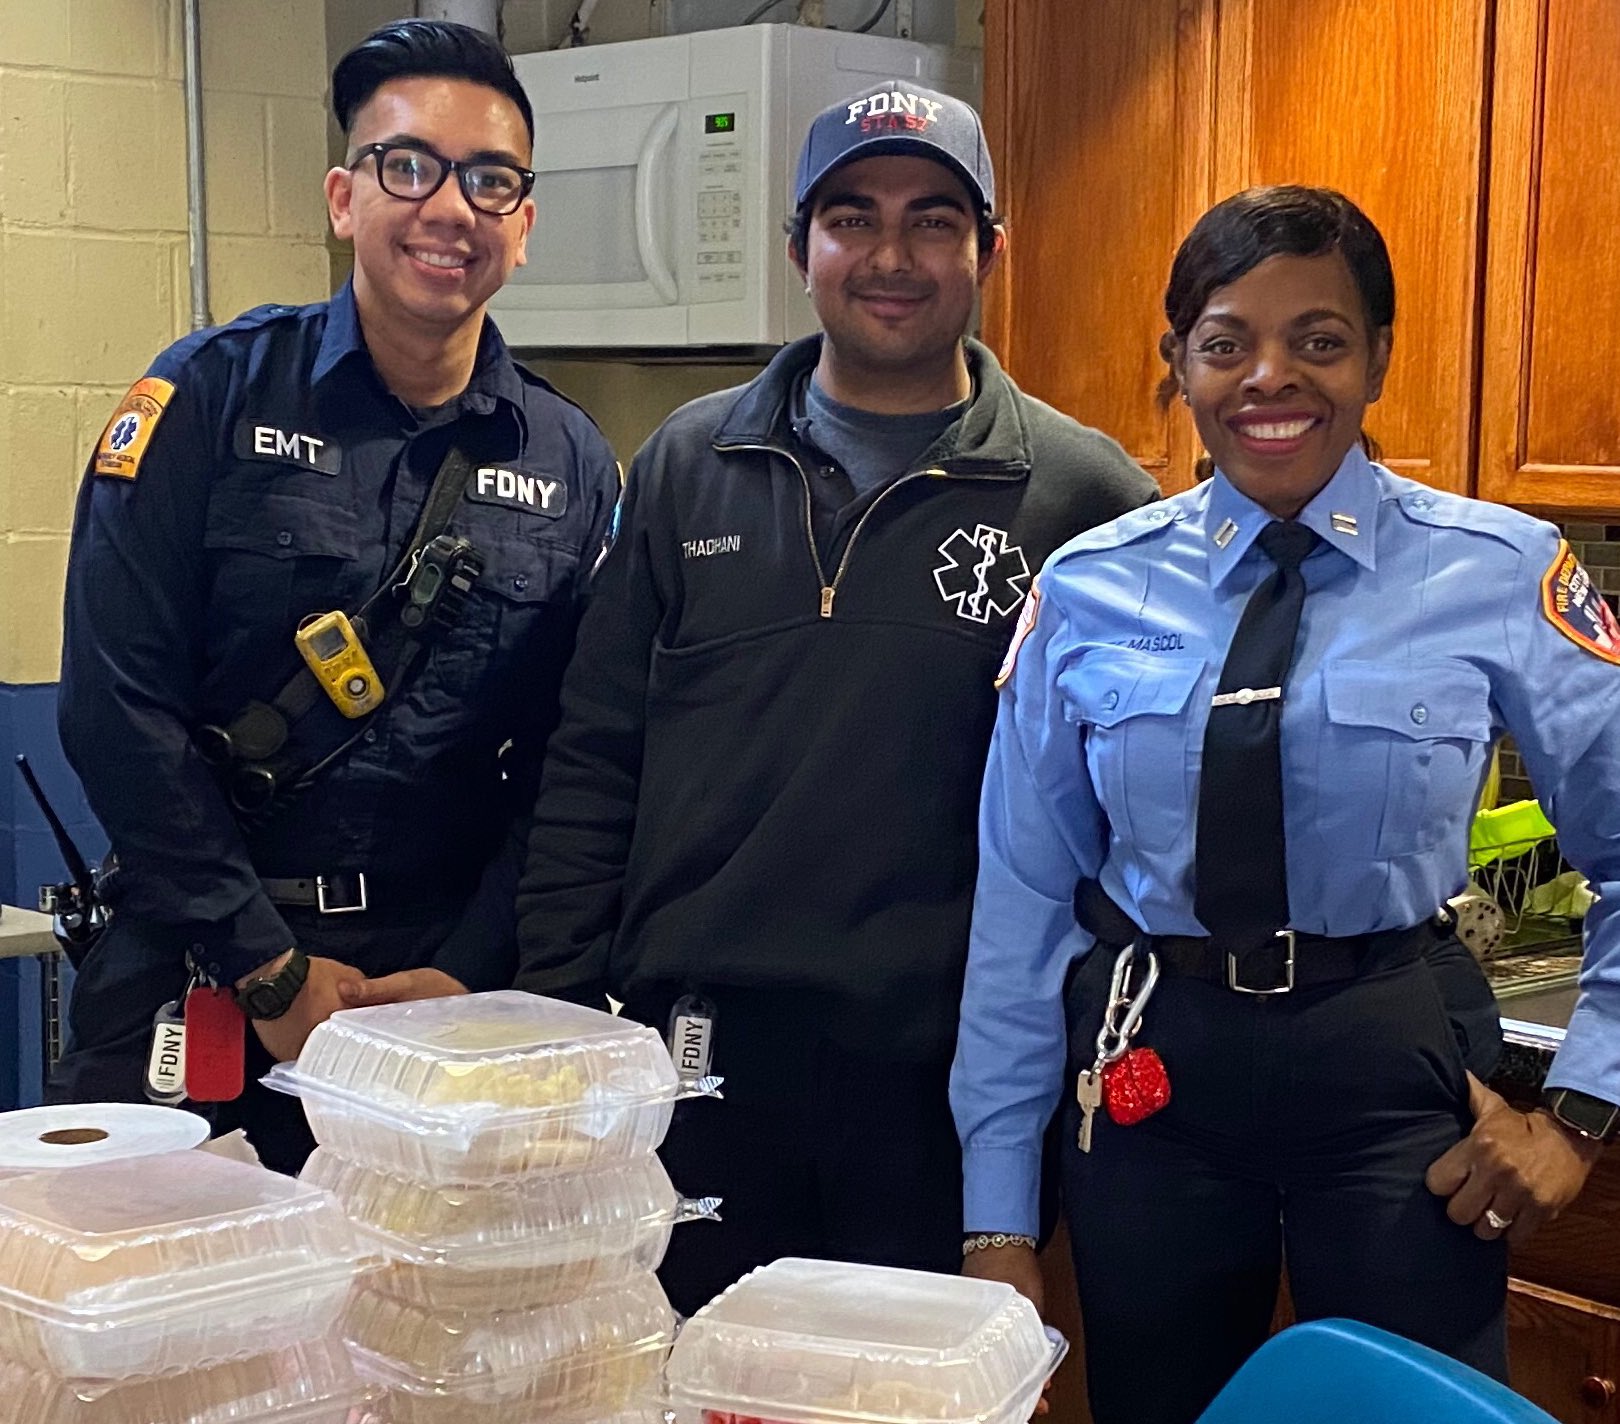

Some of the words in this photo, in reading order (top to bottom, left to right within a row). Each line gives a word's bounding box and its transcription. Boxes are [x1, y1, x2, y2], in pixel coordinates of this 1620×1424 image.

[845, 91, 943, 125] FDNY
[254, 426, 324, 464] EMT
[477, 468, 557, 509] FDNY
[682, 534, 741, 559] THADHANI
[158, 1027, 183, 1077] FDNY
[682, 1020, 704, 1070] FDNY
